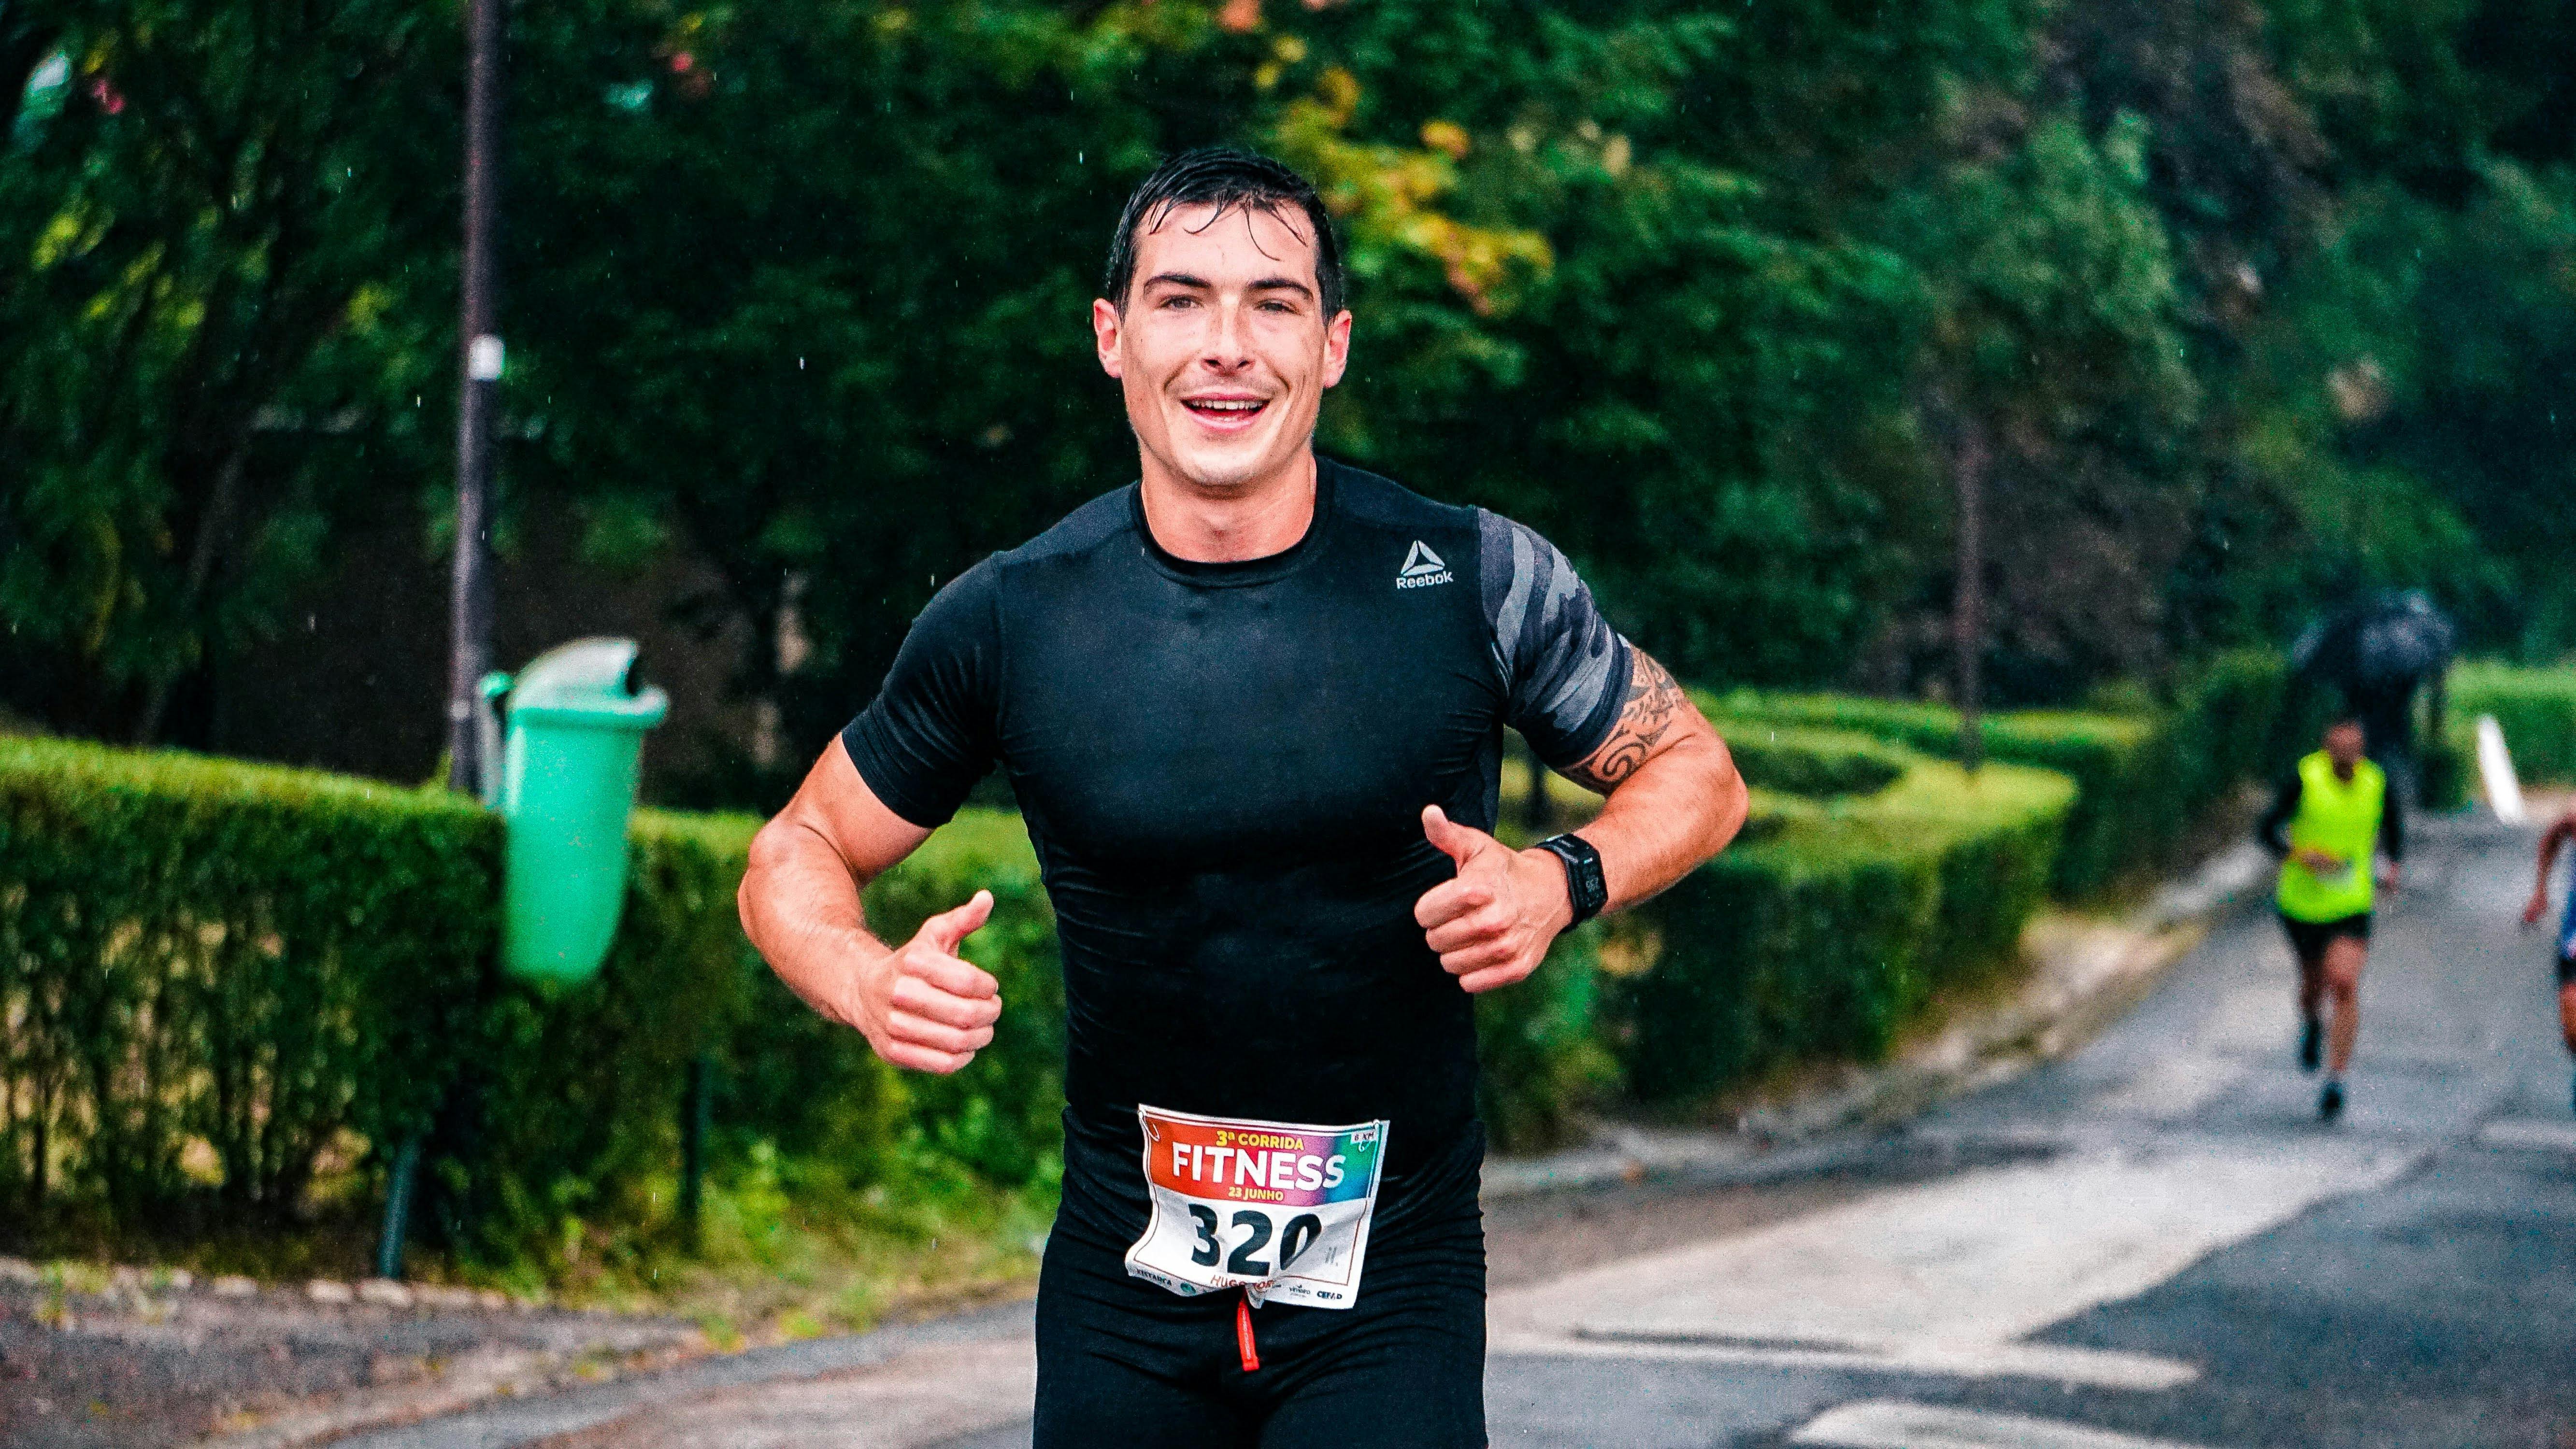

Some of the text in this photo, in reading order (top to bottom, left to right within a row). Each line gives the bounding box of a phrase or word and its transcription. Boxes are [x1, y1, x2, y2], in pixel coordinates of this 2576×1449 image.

[1396, 570, 1454, 589] Reebok
[1216, 1130, 1304, 1151] 3ª CORRIDA
[1172, 1141, 1346, 1192] FITNESS
[1228, 1186, 1284, 1201] 23 JUNHO
[1188, 1203, 1322, 1277] 320
